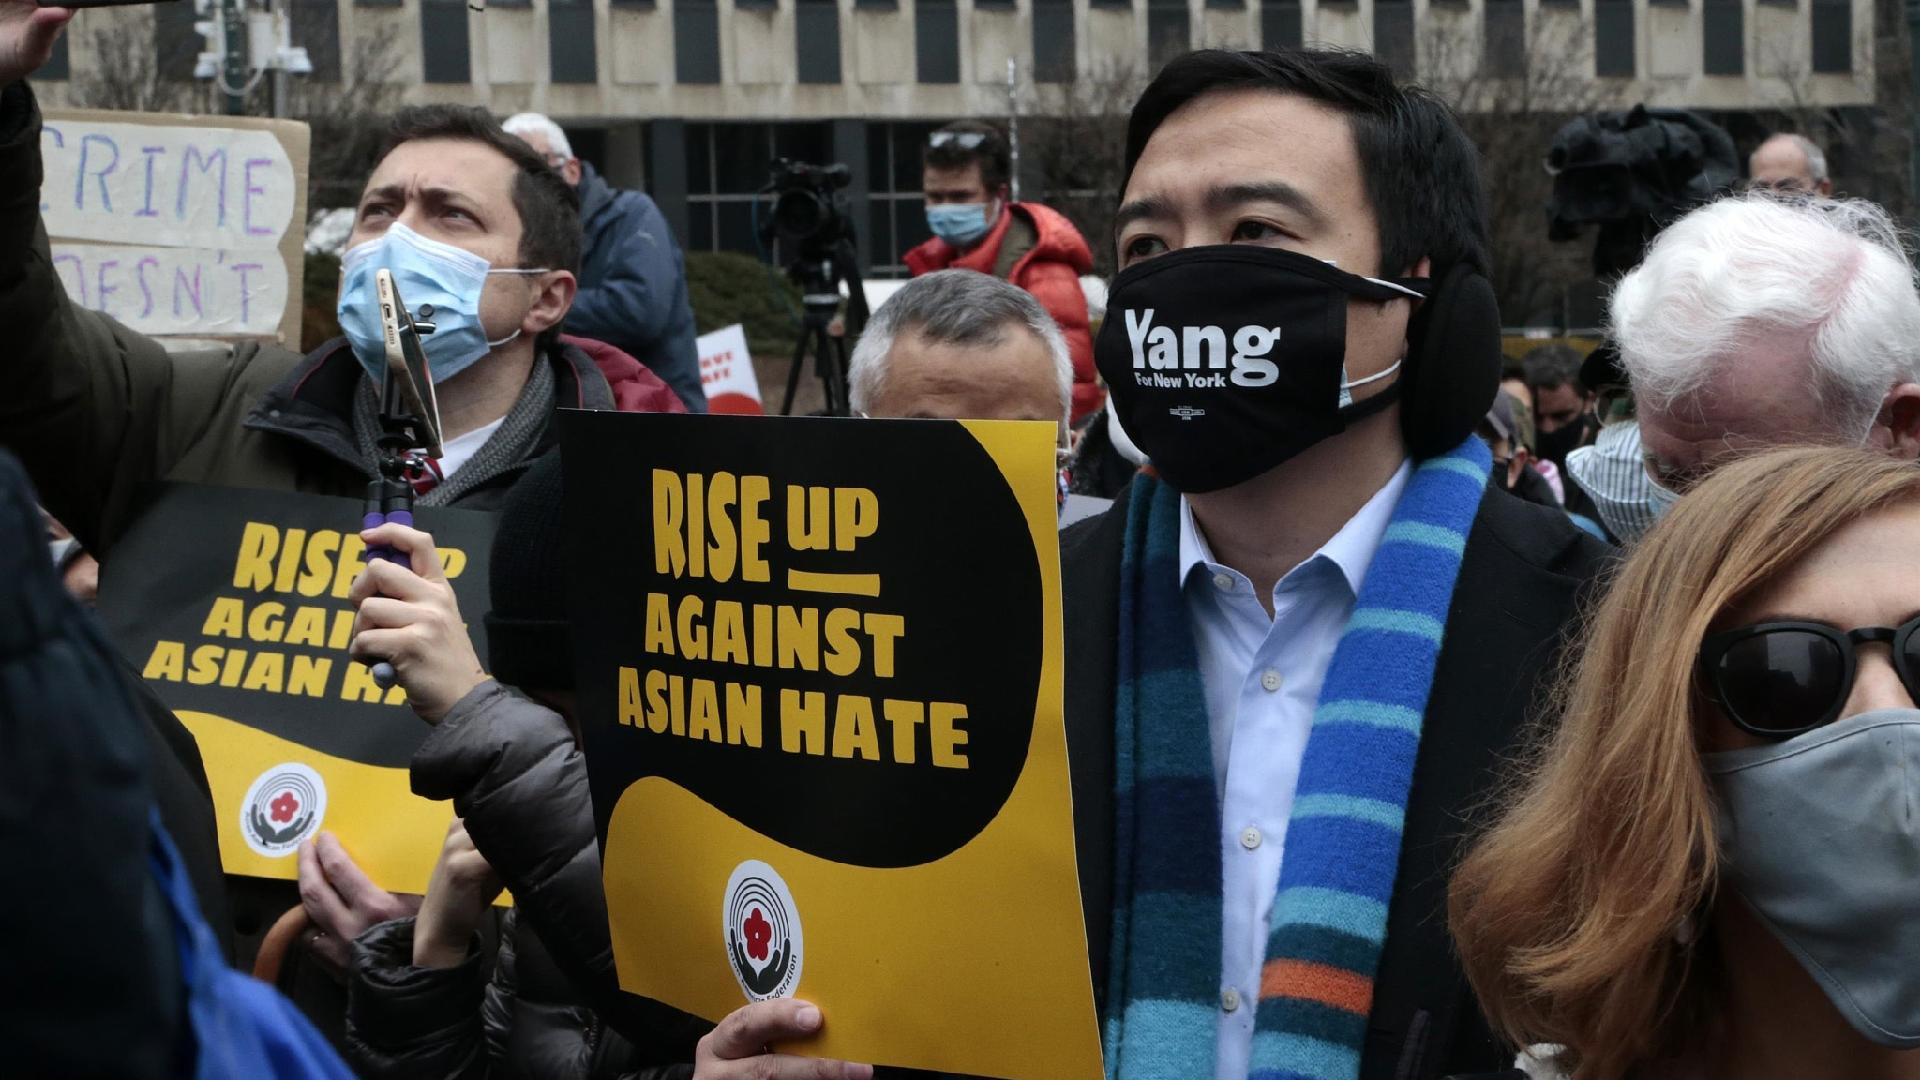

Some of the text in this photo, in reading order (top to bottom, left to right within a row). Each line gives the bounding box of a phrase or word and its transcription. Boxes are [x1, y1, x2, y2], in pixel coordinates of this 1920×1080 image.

[1125, 308, 1281, 387] Yang
[1134, 372, 1226, 388] For New York
[653, 469, 771, 583] RISE
[202, 597, 357, 650] AGAI
[645, 593, 905, 678] AGAINST
[143, 640, 332, 698] ASIAN
[618, 666, 970, 769] ASIAN HATE
